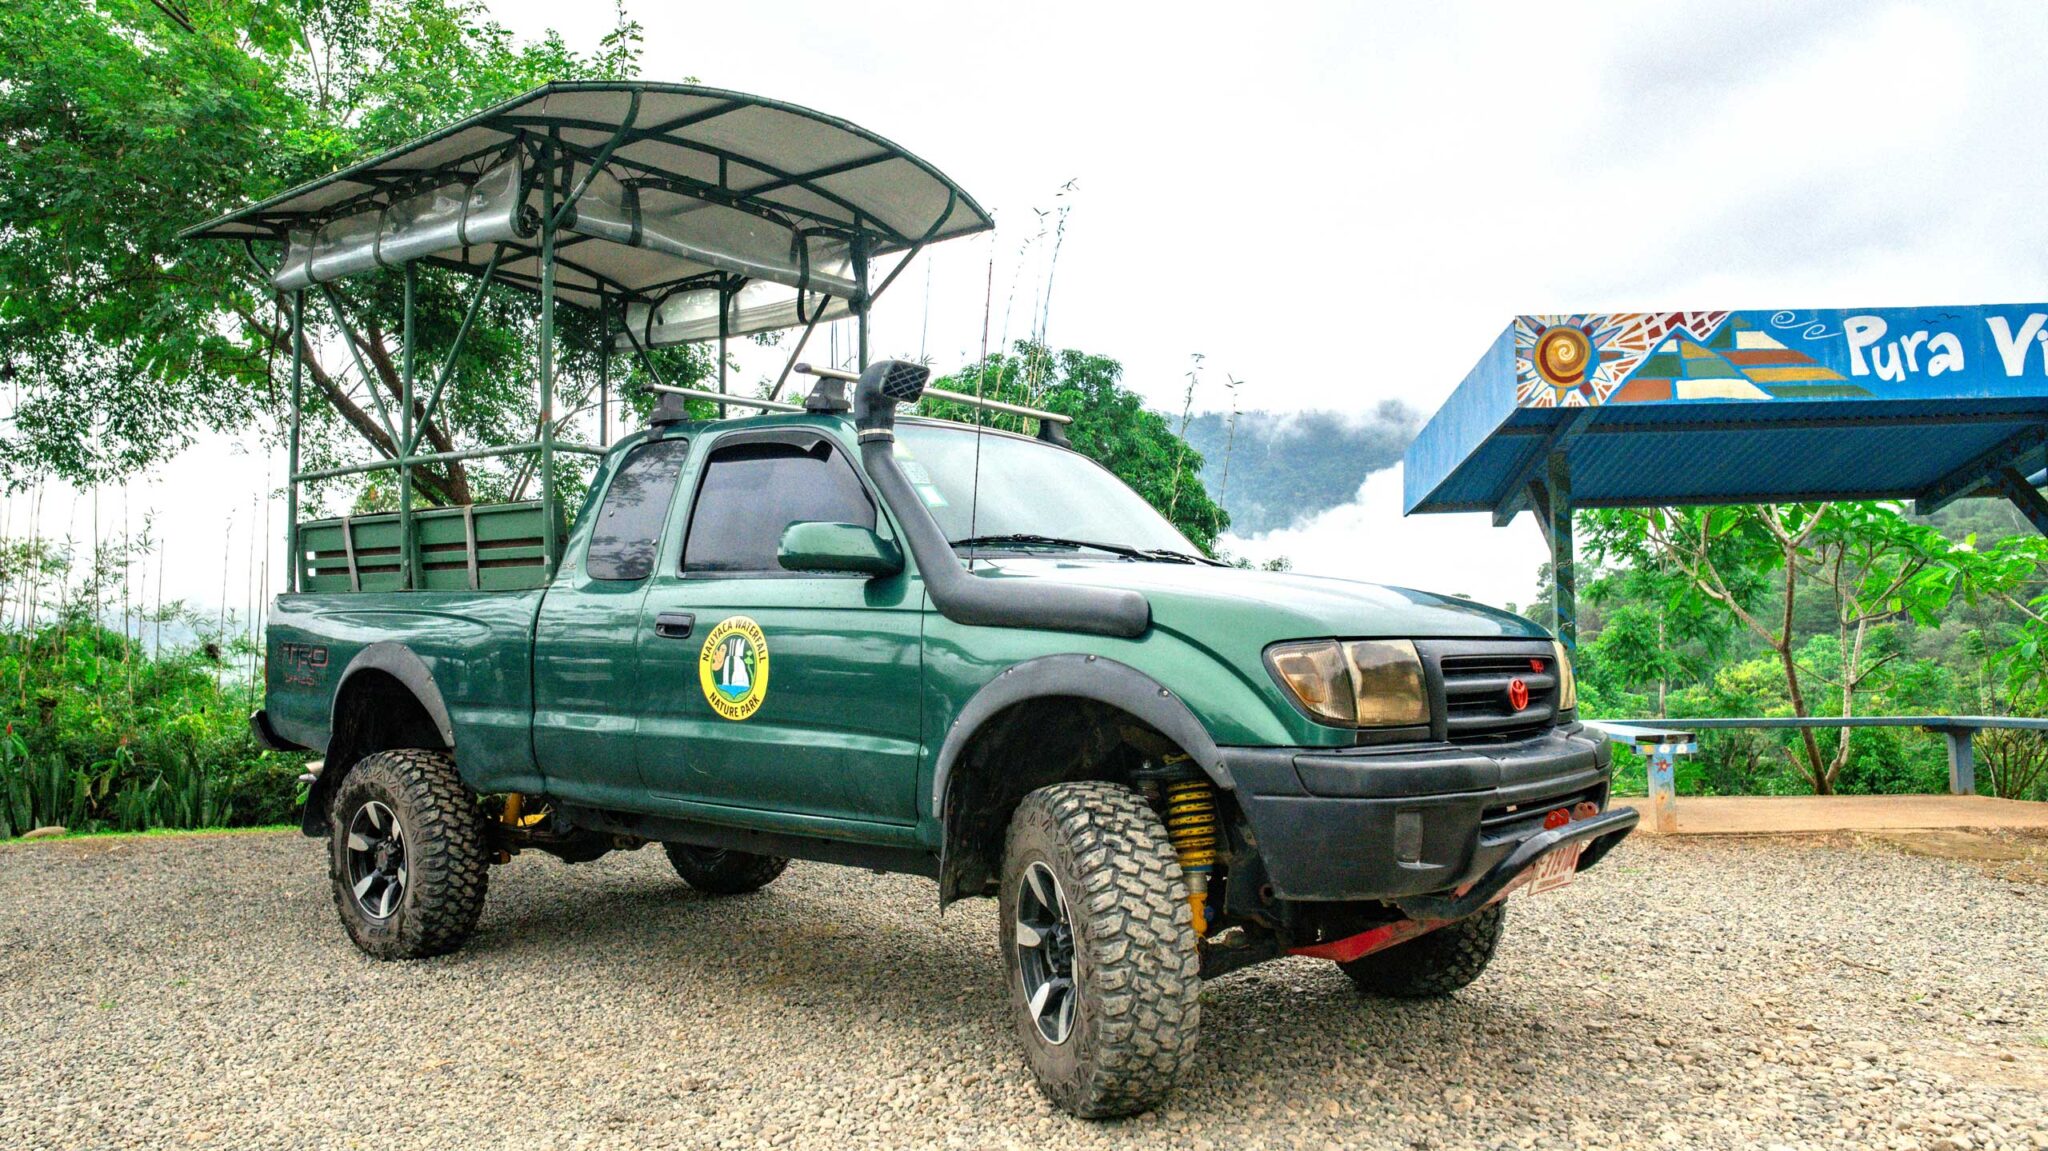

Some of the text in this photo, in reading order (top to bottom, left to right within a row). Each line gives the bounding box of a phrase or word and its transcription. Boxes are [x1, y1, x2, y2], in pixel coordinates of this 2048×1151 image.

[1843, 315, 1964, 383] Pura
[702, 619, 767, 664] NAUYACA WATERFALL
[709, 692, 760, 718] NATURE PARK
